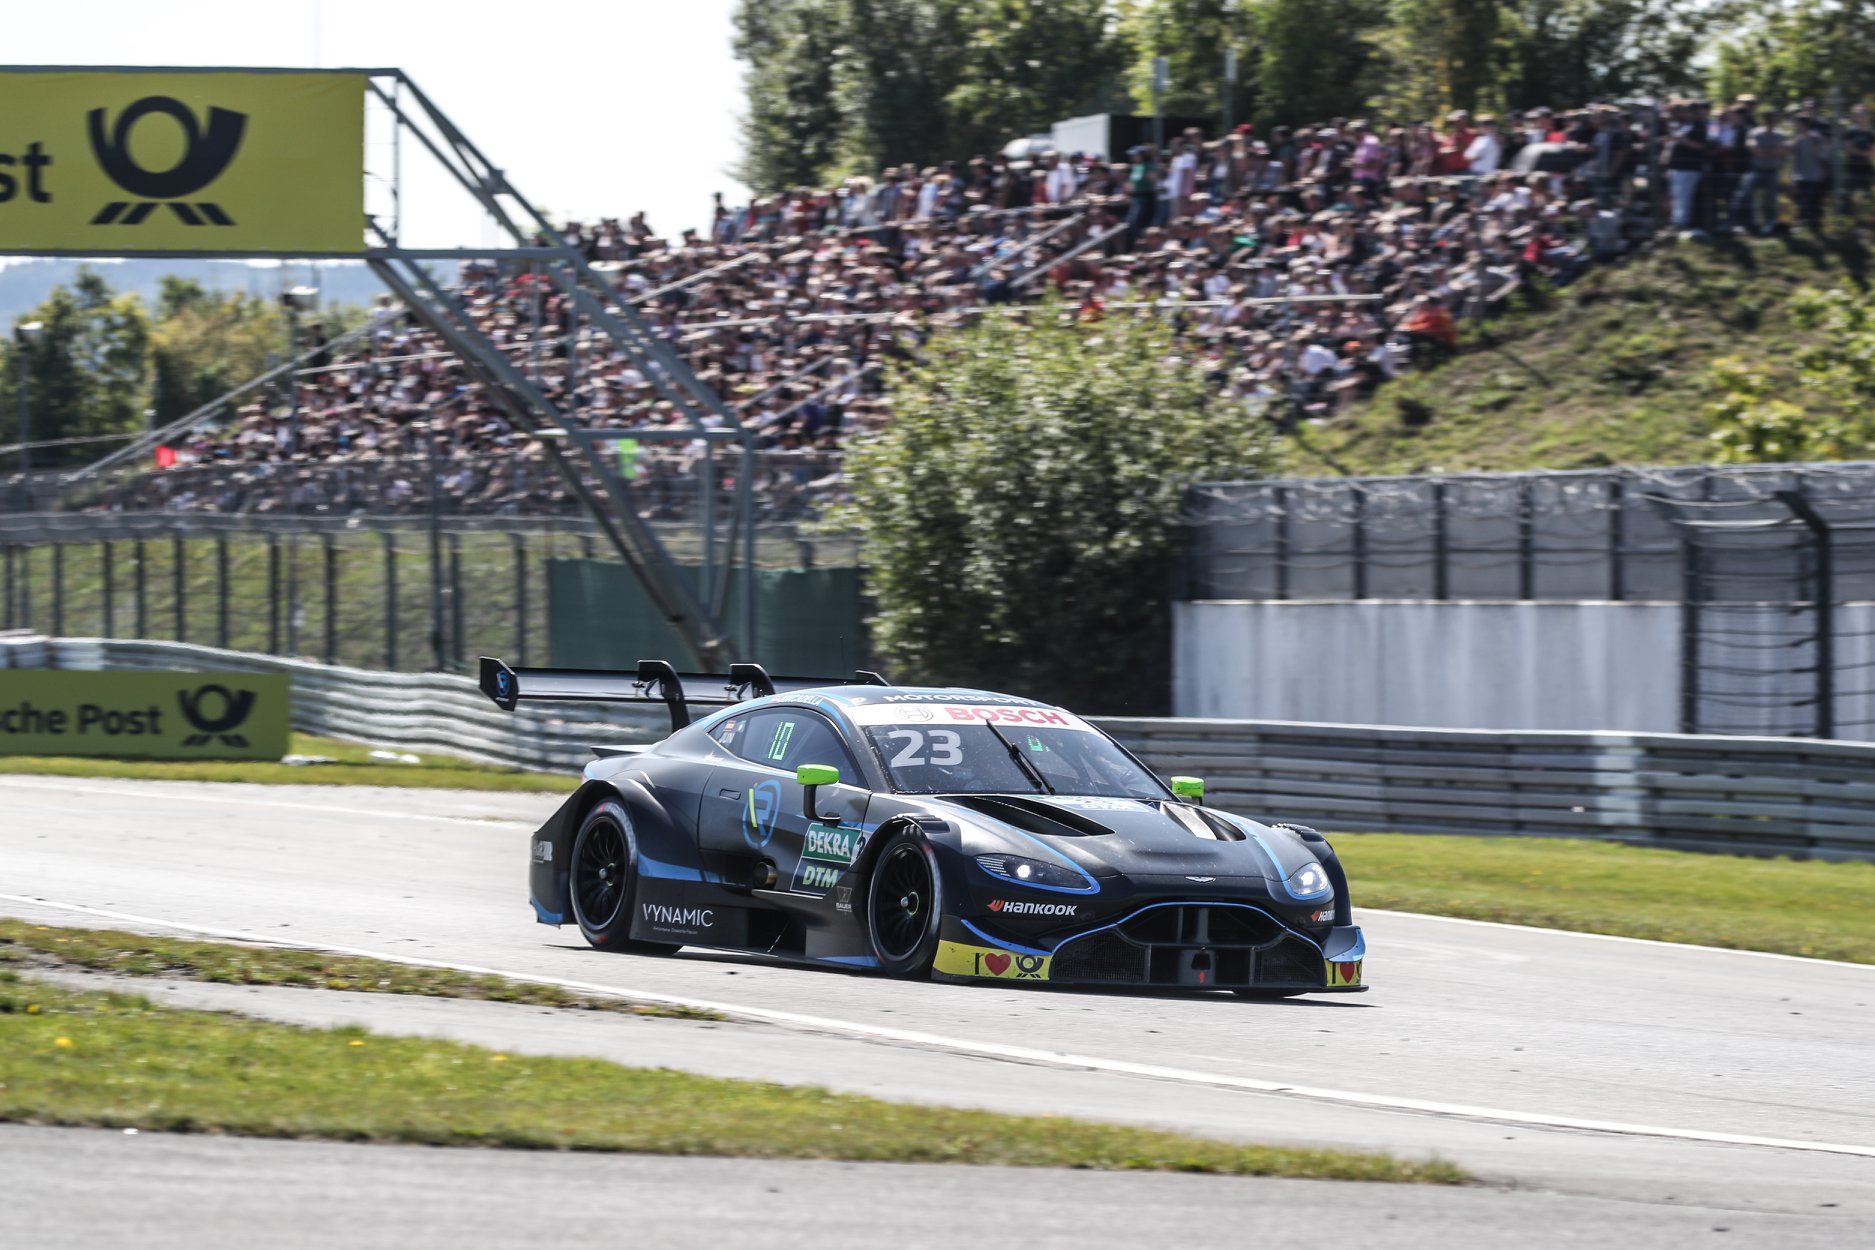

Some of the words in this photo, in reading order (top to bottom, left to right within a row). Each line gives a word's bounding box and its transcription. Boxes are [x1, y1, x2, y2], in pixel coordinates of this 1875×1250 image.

[883, 694, 1040, 706] MOTORSPORT
[77, 704, 163, 735] Post
[944, 707, 1070, 725] BOSCH
[888, 729, 963, 767] 23
[808, 830, 851, 857] DEKRA
[802, 865, 839, 888] DTM
[642, 903, 714, 927] VYNAMIC
